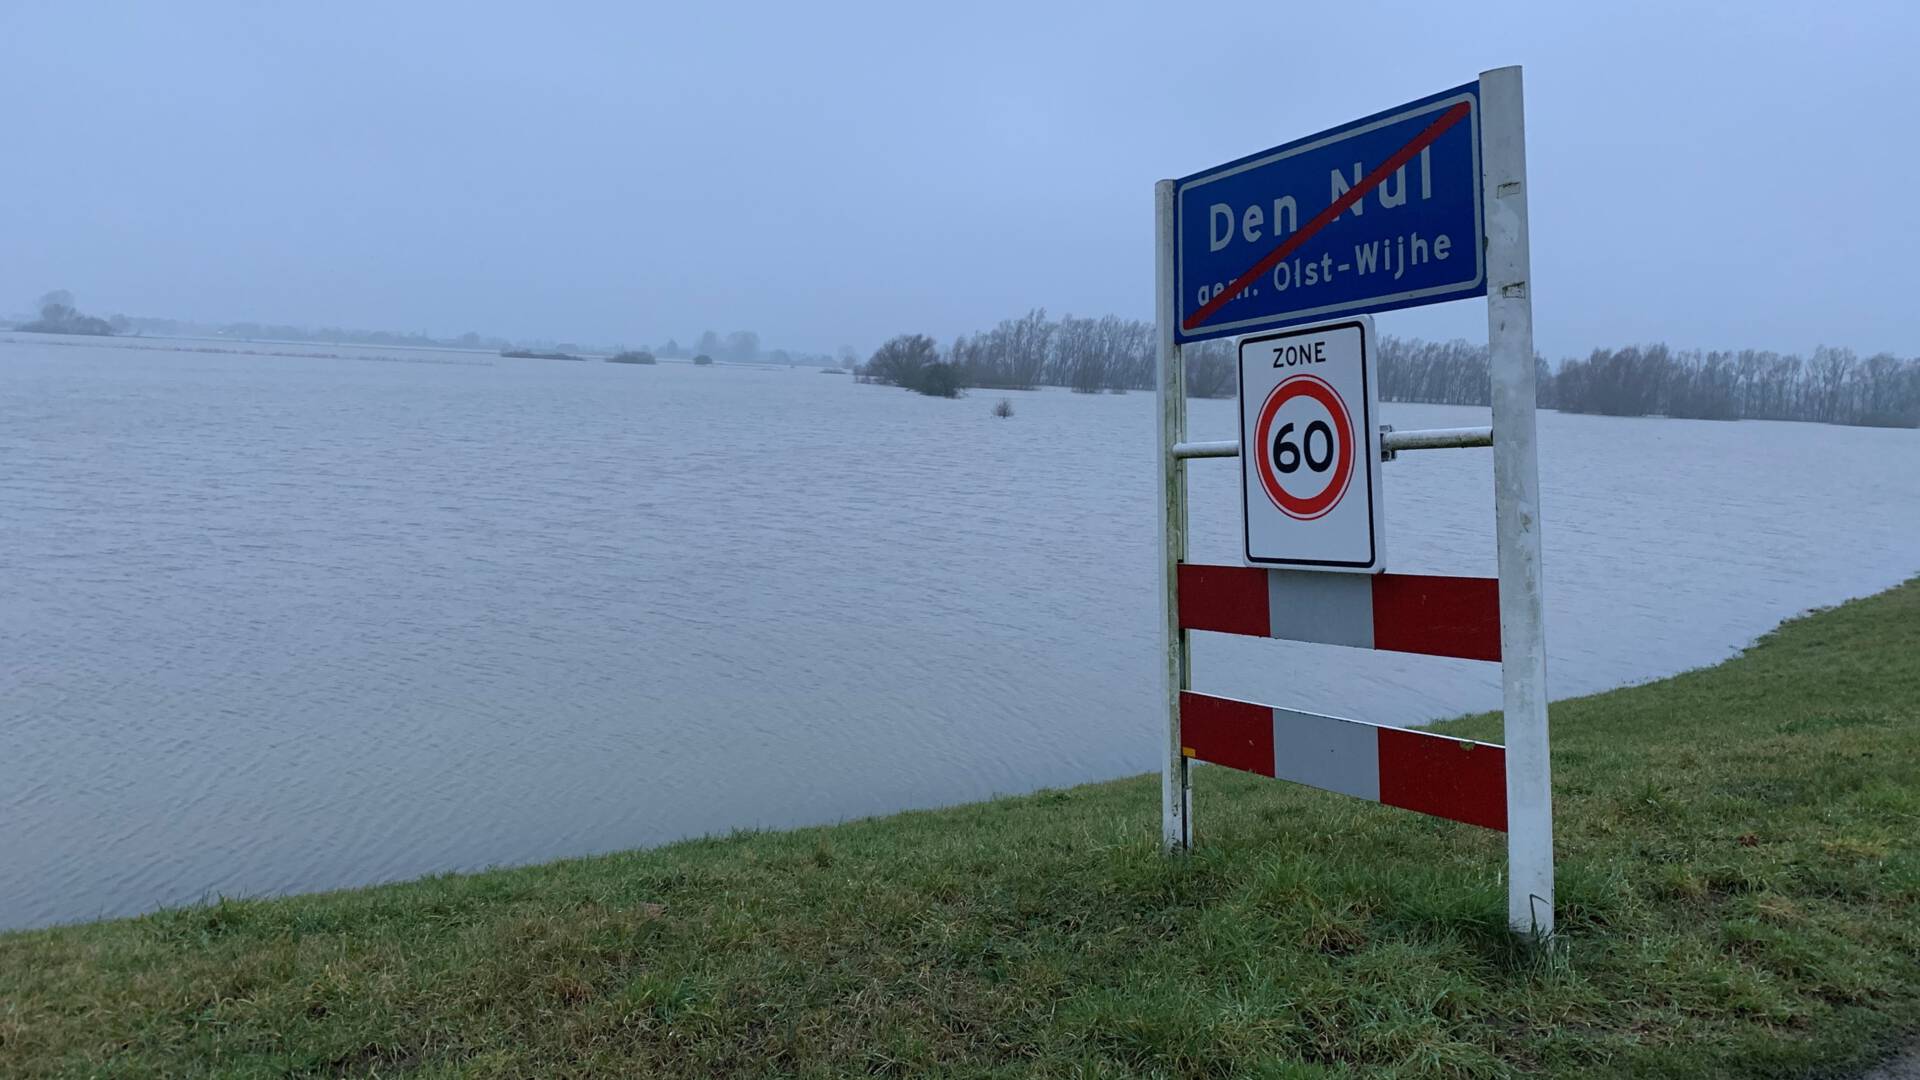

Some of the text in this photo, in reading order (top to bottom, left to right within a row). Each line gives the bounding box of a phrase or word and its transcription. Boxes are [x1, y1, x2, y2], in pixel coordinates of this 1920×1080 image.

[1209, 144, 1432, 253] Den Nul
[1273, 232, 1452, 292] Olst-Wijhe
[1273, 342, 1326, 368] ZONE
[1273, 420, 1334, 474] 60
